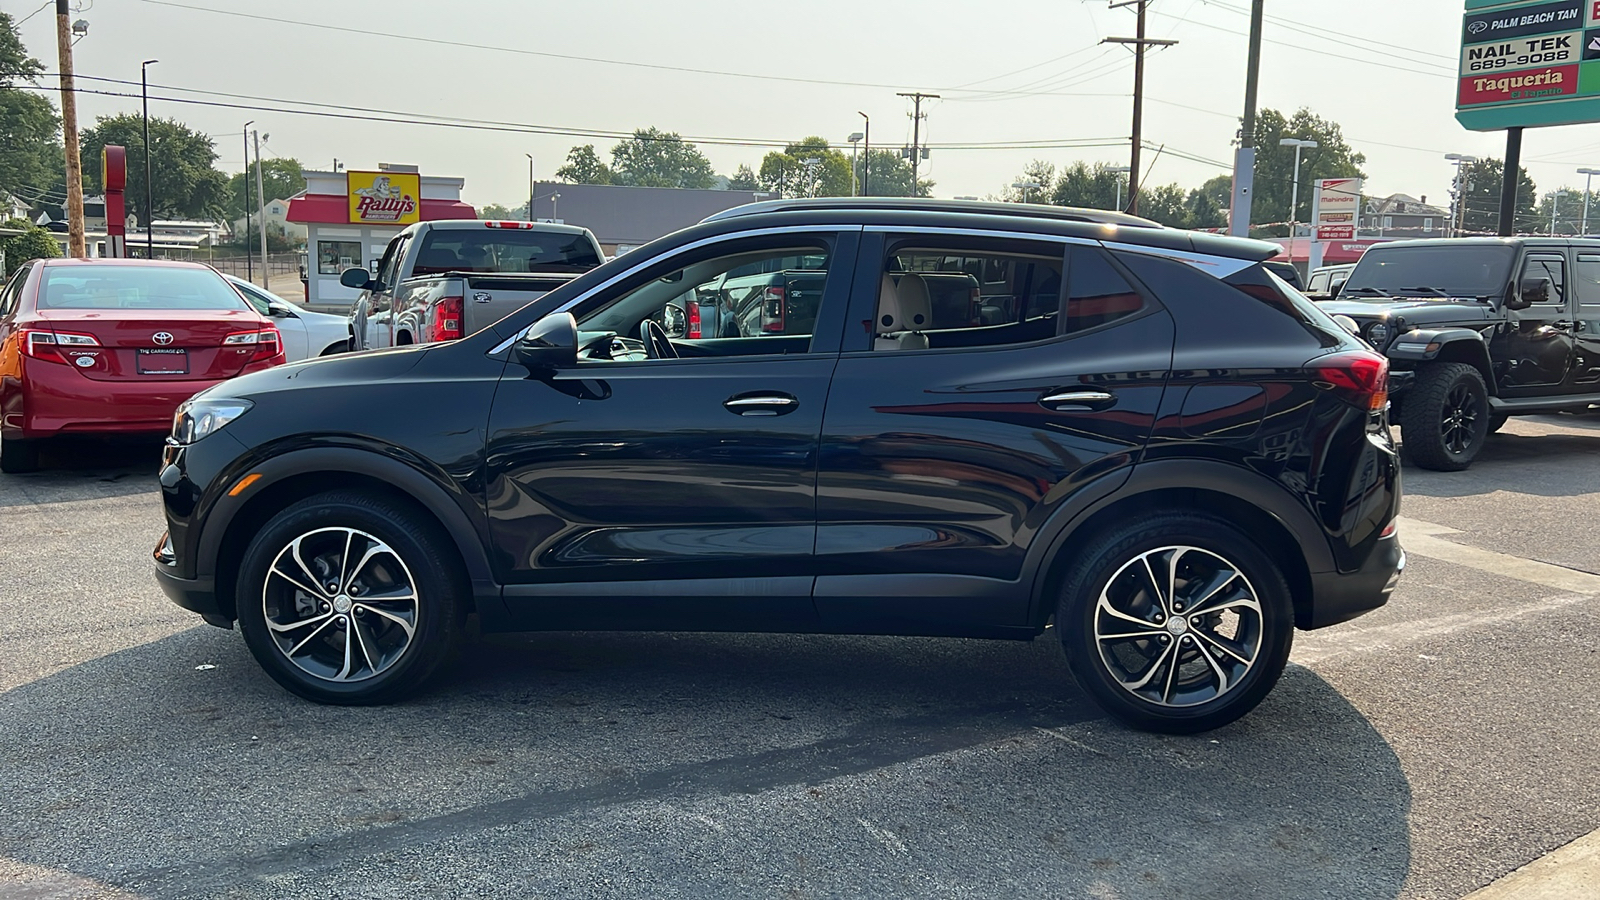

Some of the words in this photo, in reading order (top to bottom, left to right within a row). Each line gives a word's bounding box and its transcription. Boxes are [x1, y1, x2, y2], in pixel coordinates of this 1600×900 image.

[1491, 17, 1519, 30] PALM
[1520, 11, 1555, 26] BEACH
[1557, 8, 1578, 20] TAN
[1468, 44, 1516, 60] NAIL
[1526, 35, 1571, 52] TEK
[1470, 50, 1569, 71] 689-9088
[1511, 91, 1521, 99] El
[356, 194, 415, 220] Rally's
